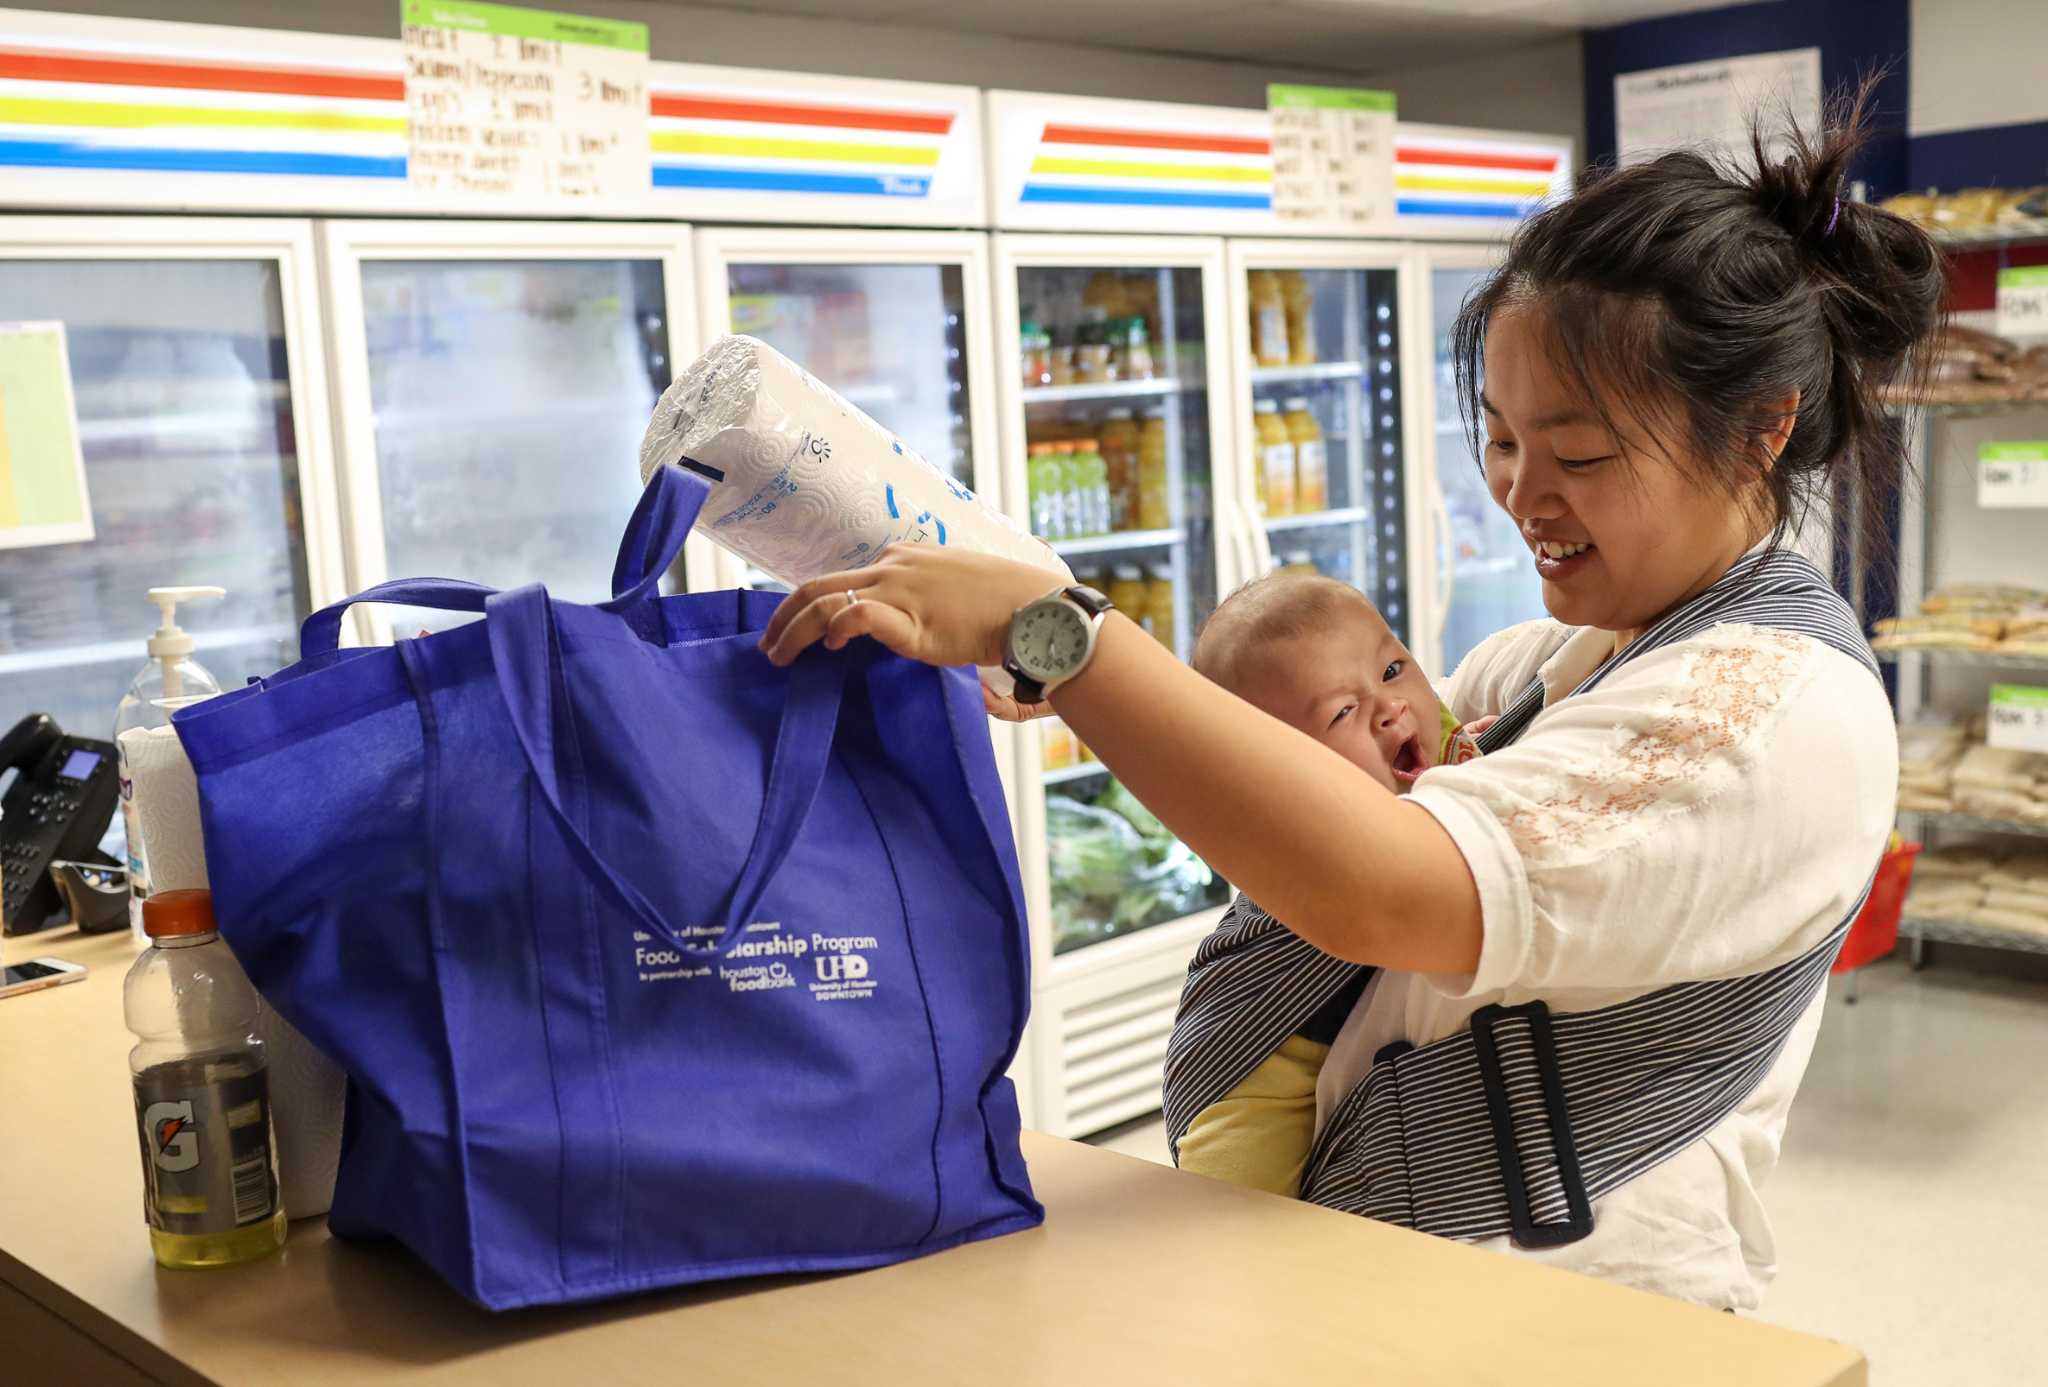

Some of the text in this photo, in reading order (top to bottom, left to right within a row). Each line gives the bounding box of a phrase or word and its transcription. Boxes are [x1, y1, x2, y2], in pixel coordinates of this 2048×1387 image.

[811, 933, 878, 954] Program
[649, 967, 694, 982] partnership
[694, 965, 712, 976] with
[719, 965, 768, 980] houston
[815, 954, 869, 981] UHD
[816, 989, 873, 1001] DOWNTOWN
[144, 1100, 200, 1173] G
